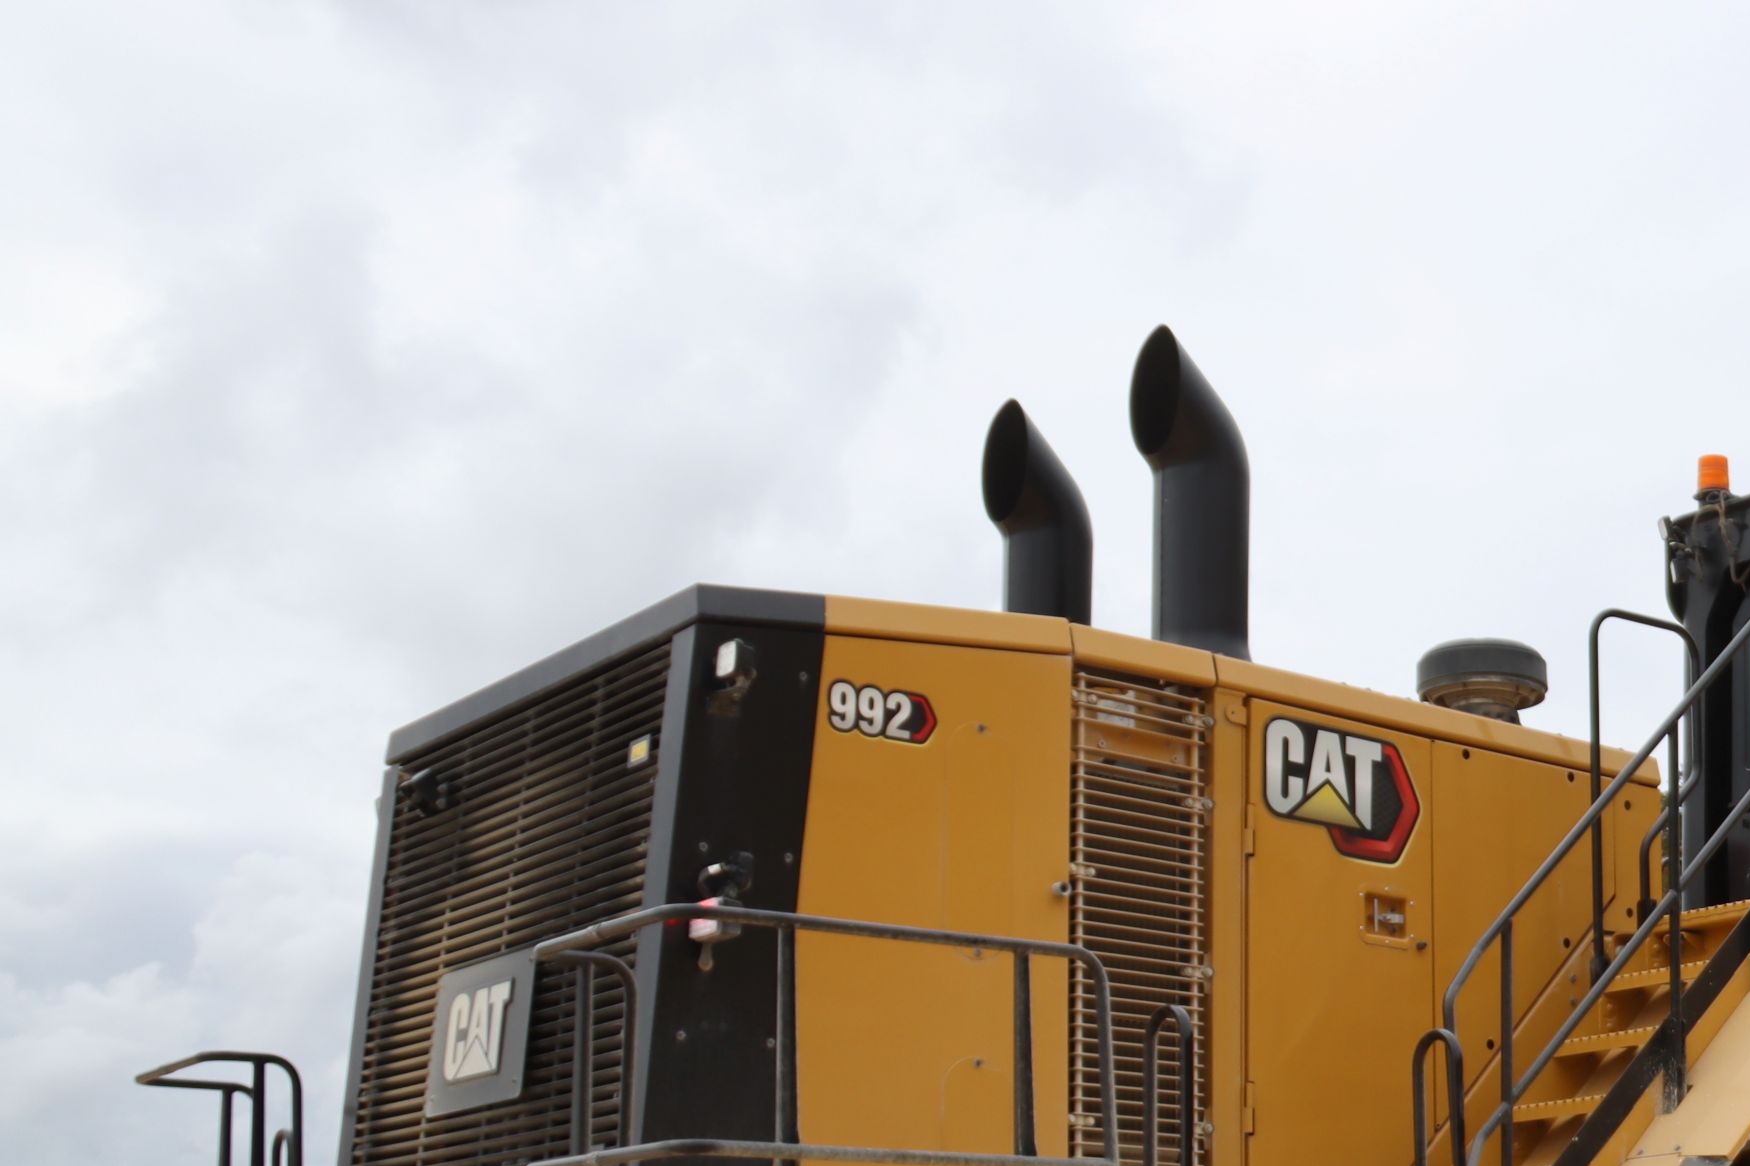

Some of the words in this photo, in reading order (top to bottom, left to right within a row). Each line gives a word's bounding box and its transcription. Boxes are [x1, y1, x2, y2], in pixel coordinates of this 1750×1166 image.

[830, 682, 912, 740] 992
[1265, 718, 1382, 831] CAT
[444, 980, 513, 1081] CAT
